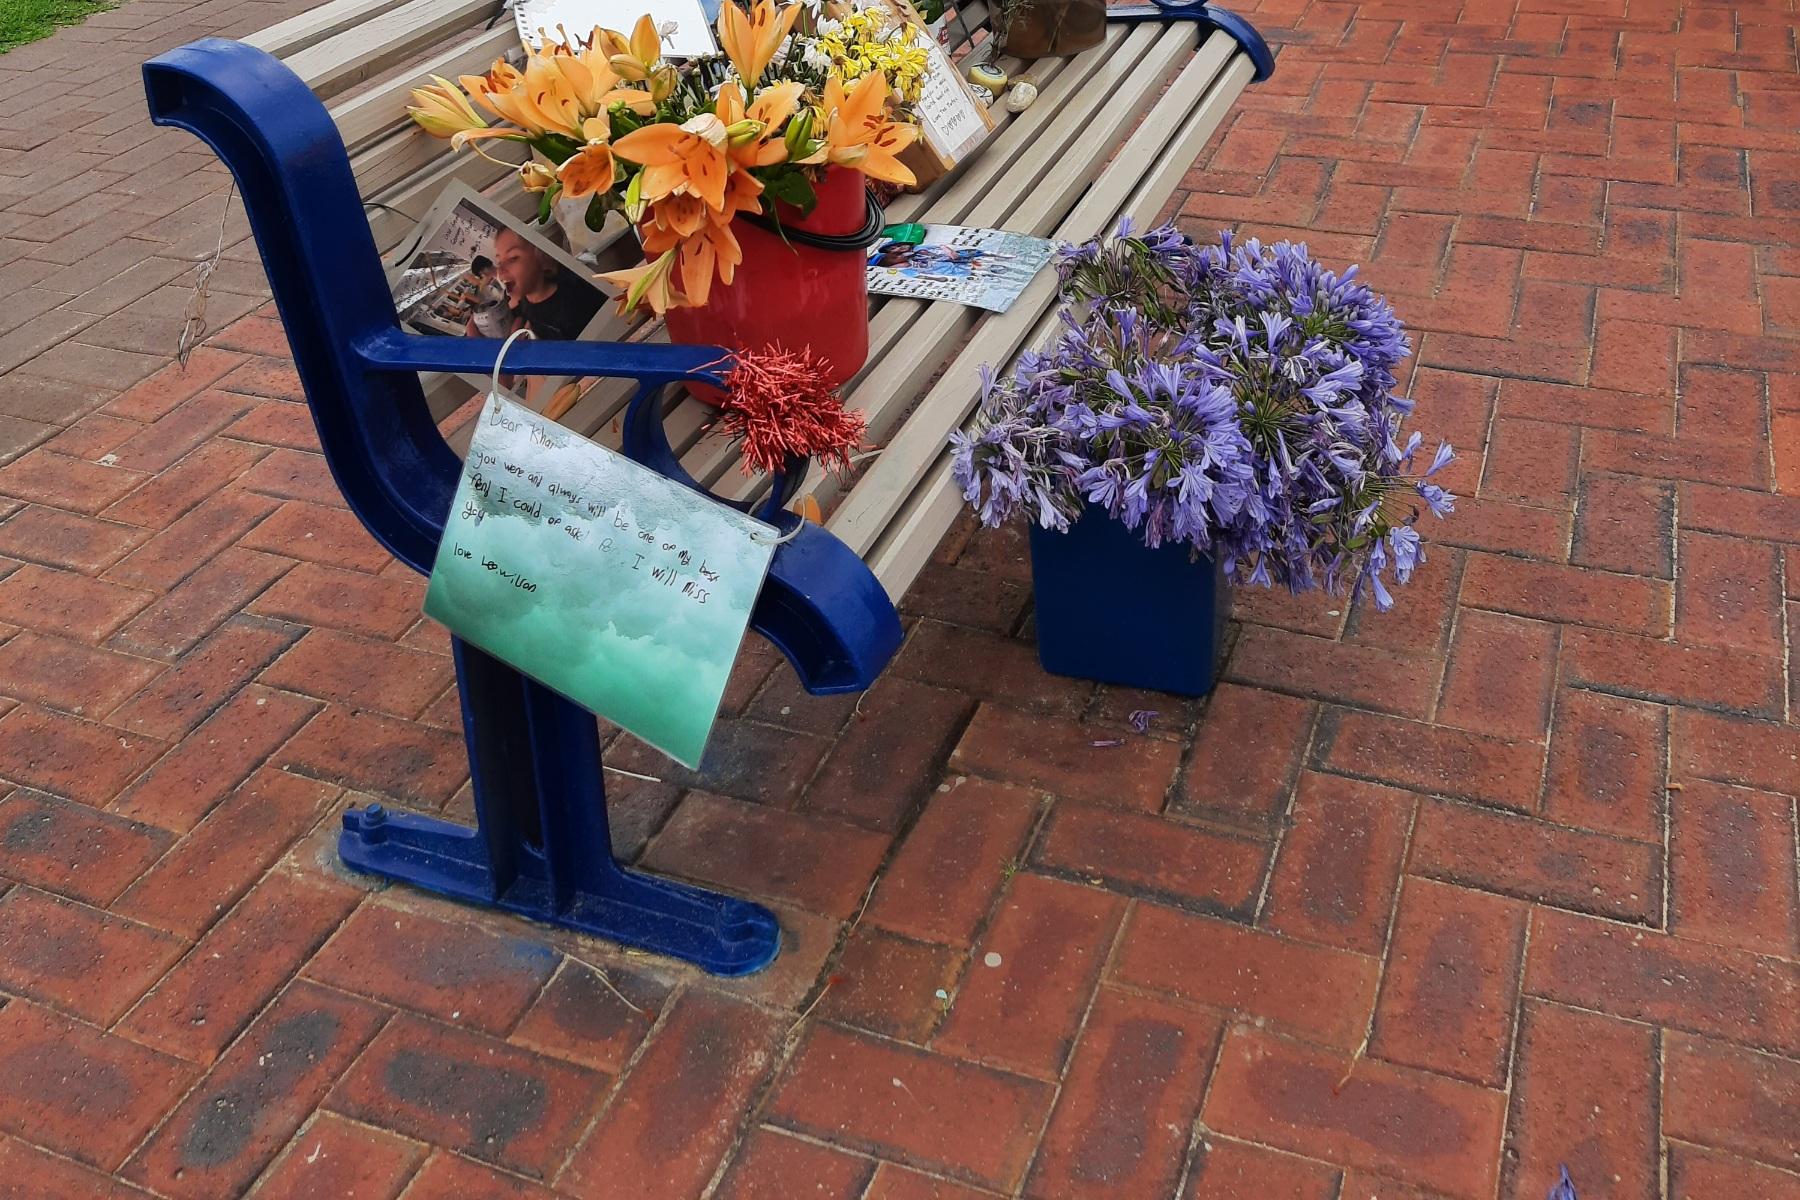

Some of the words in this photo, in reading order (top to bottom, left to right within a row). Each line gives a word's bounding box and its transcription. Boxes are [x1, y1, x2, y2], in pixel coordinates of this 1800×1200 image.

[490, 408, 523, 433] Dear
[472, 452, 496, 470] you
[504, 461, 525, 478] were
[528, 473, 544, 488] and
[548, 483, 584, 504] always
[587, 501, 607, 518] will
[613, 510, 629, 531] be
[638, 530, 655, 544] one
[497, 486, 508, 504] I
[513, 499, 542, 518] could
[631, 553, 646, 570] I
[651, 565, 678, 587] will
